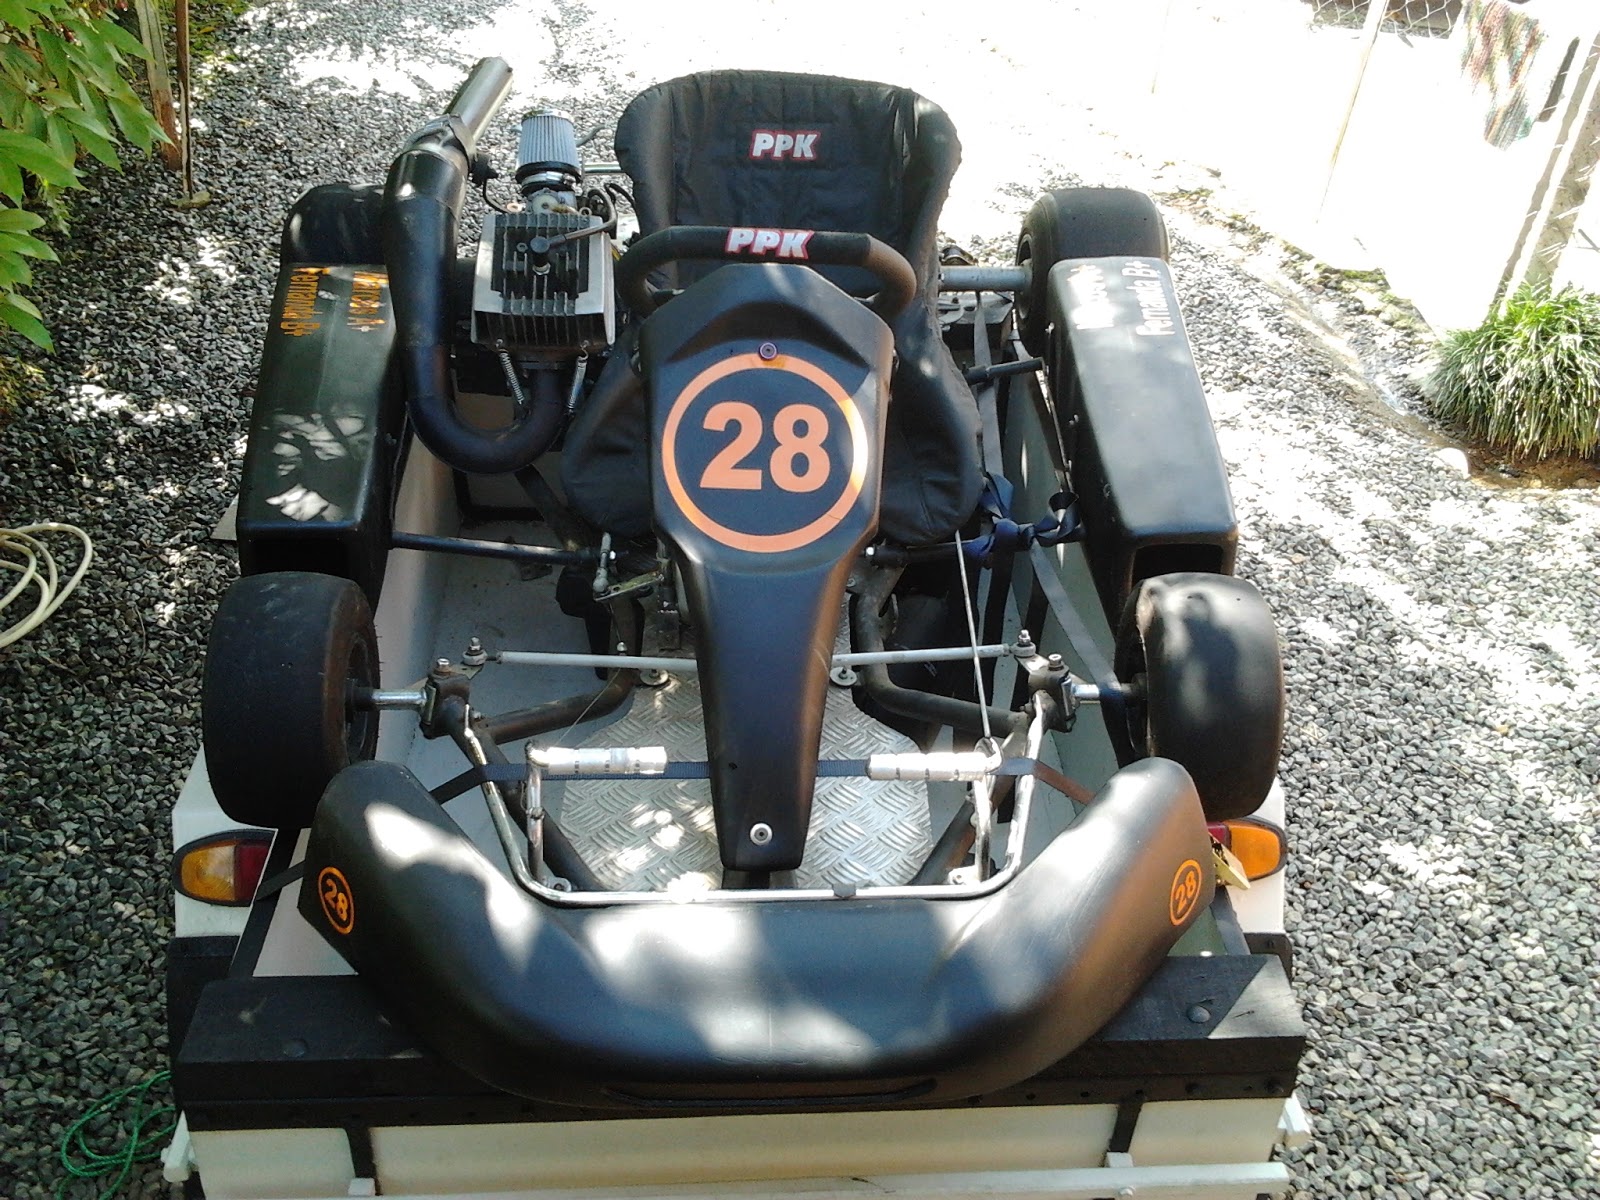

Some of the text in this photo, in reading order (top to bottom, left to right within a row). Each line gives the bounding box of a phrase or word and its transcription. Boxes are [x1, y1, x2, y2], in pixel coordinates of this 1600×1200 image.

[751, 131, 818, 159] PPK
[726, 228, 811, 259] PPK
[280, 267, 331, 336] Fernanda B+
[1121, 261, 1176, 335] Fernanda B+
[700, 401, 831, 493] 28
[325, 879, 348, 921] 28
[1175, 870, 1197, 915] 28
